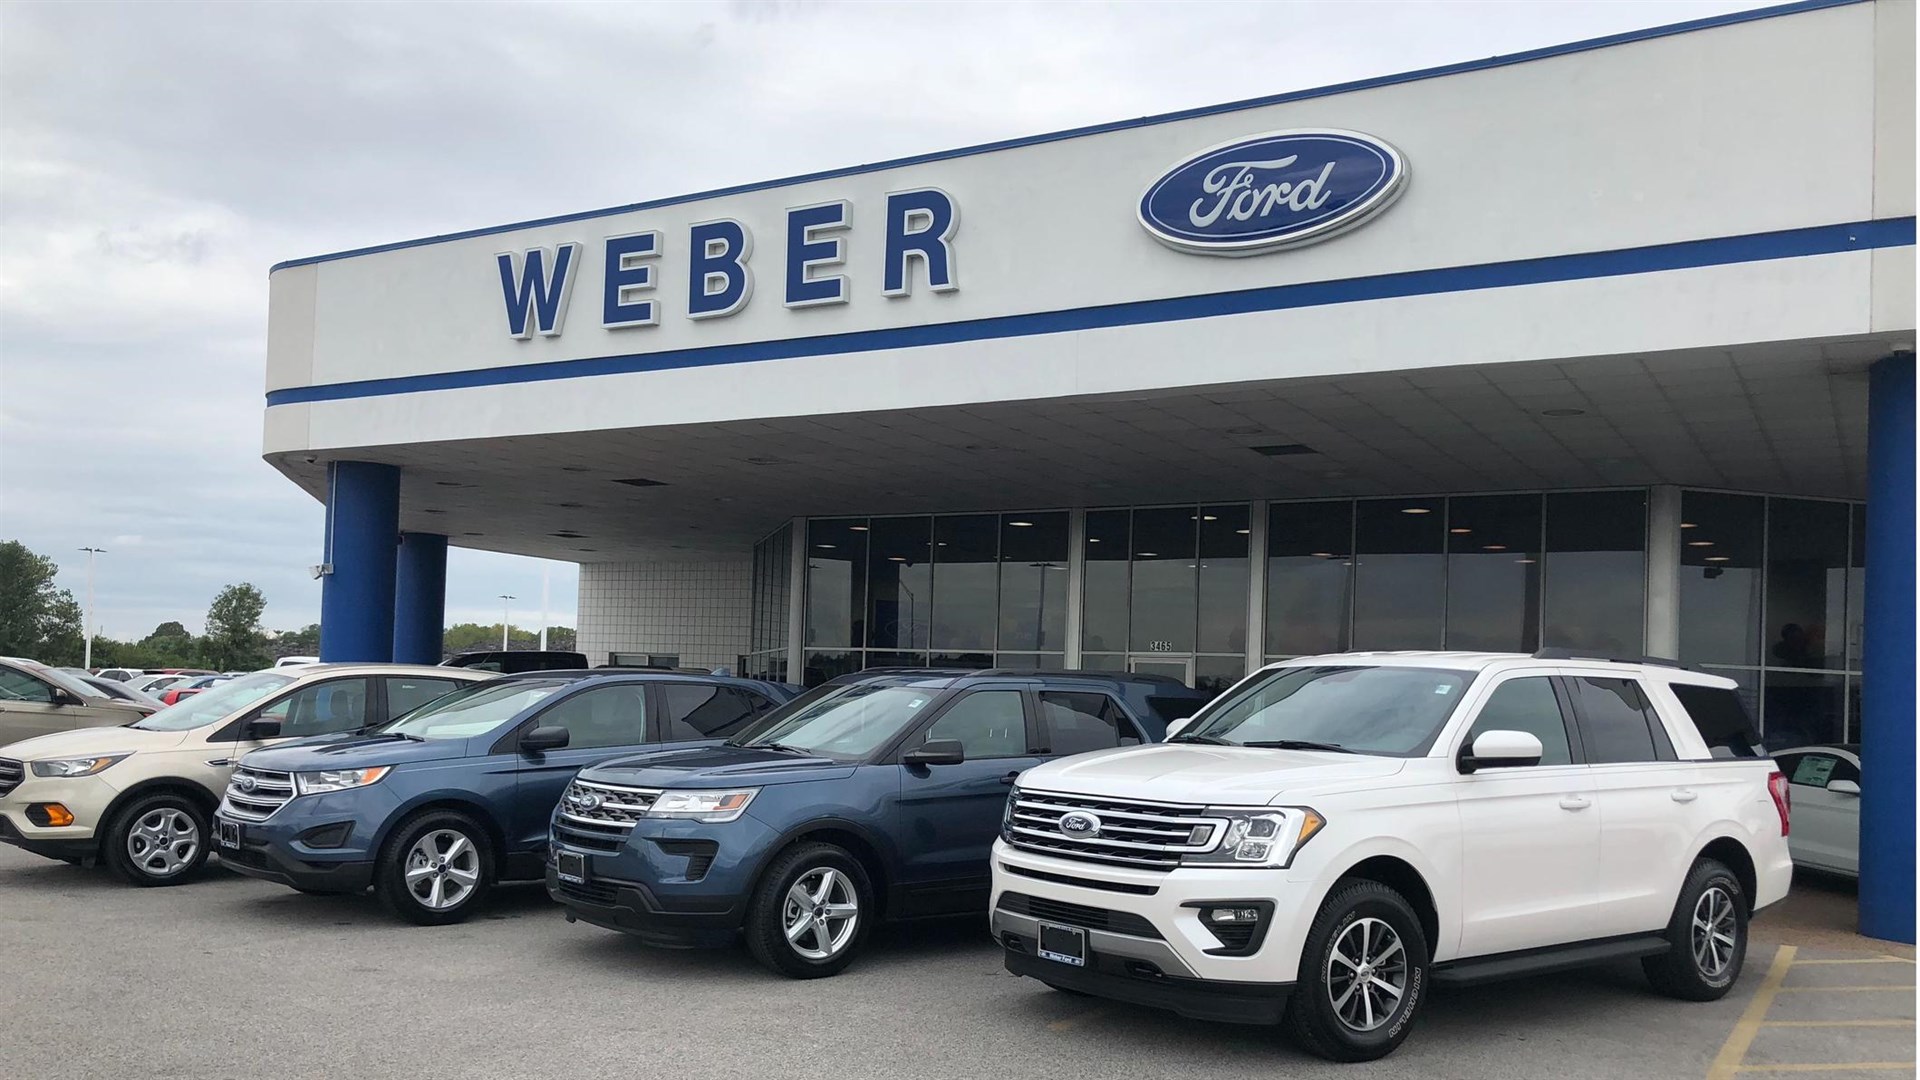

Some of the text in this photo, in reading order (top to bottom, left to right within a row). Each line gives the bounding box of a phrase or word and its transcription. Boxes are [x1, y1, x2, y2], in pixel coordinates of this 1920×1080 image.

[1189, 154, 1336, 228] Ford
[494, 186, 961, 341] WEBER
[1150, 640, 1172, 652] 3465
[1065, 816, 1087, 830] Ford
[1388, 966, 1421, 1038] MICHELIN
